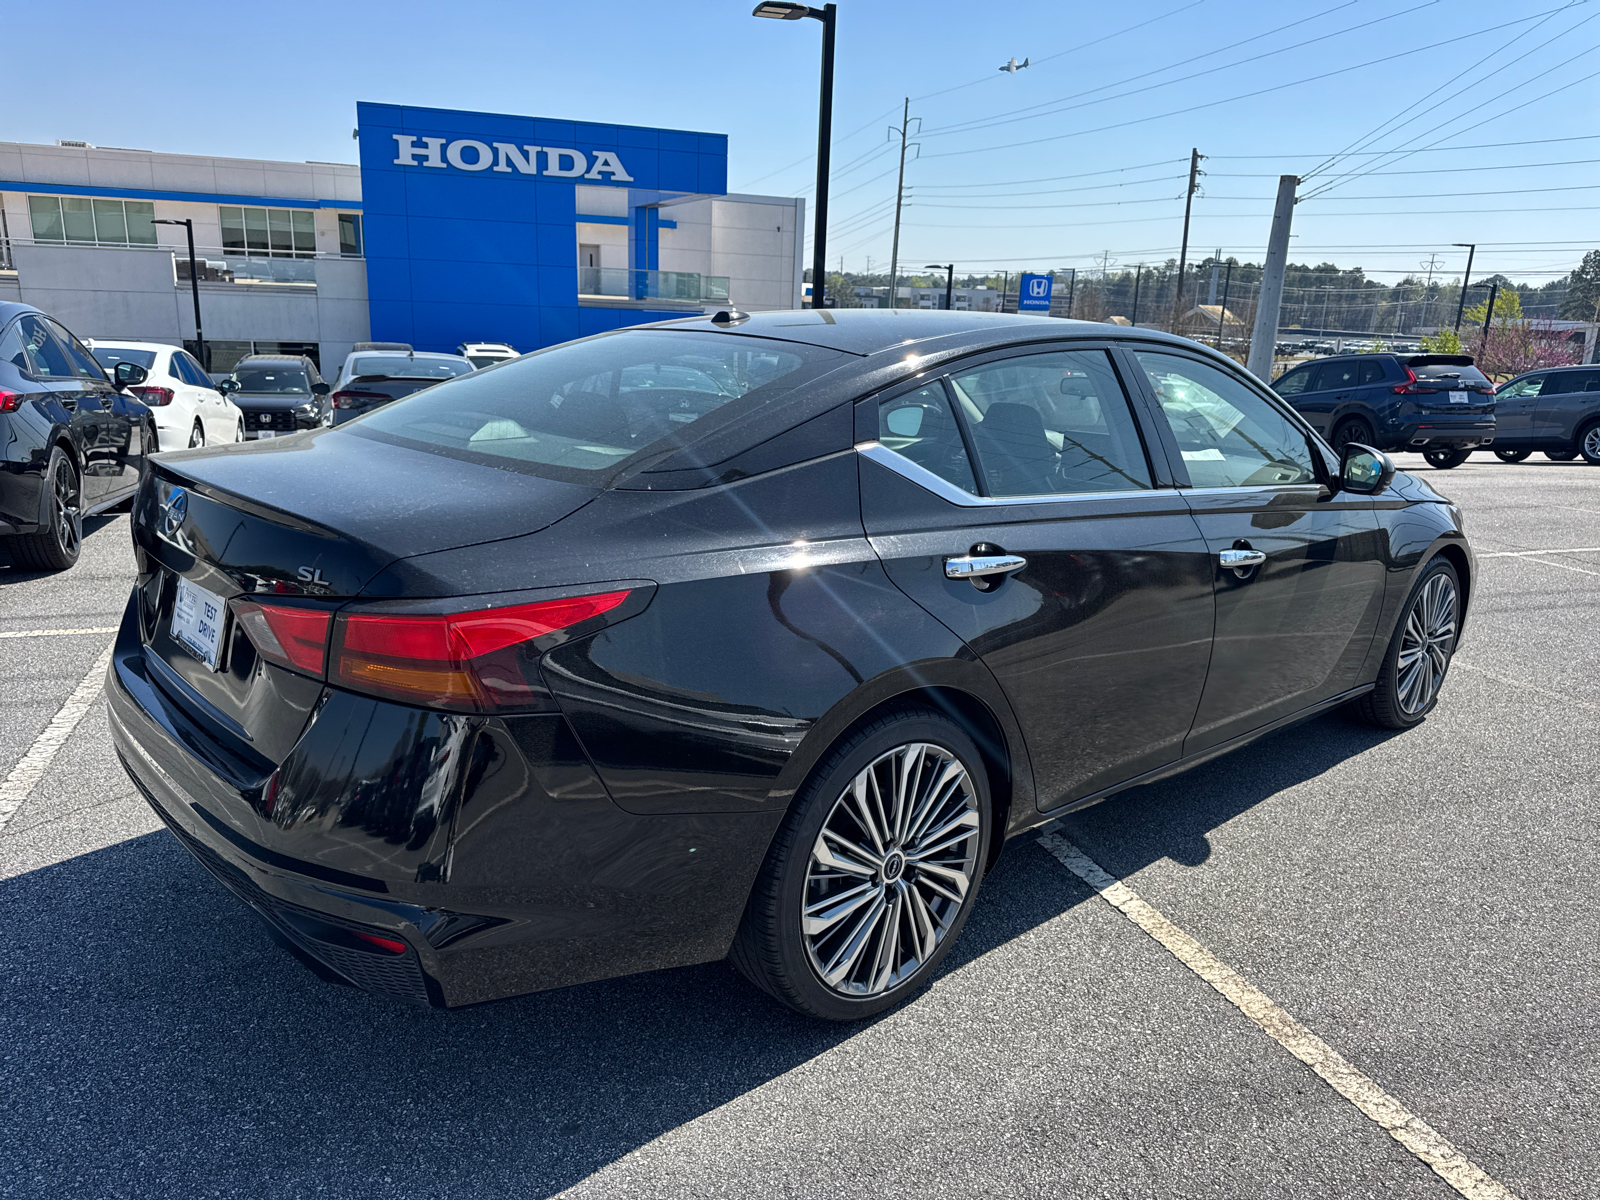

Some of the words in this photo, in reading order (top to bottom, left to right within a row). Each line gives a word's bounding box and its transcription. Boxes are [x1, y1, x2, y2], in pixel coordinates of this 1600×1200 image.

[392, 133, 634, 182] HONDA
[297, 565, 330, 586] SL
[204, 601, 218, 622] TEST
[198, 619, 216, 643] DRIVE
